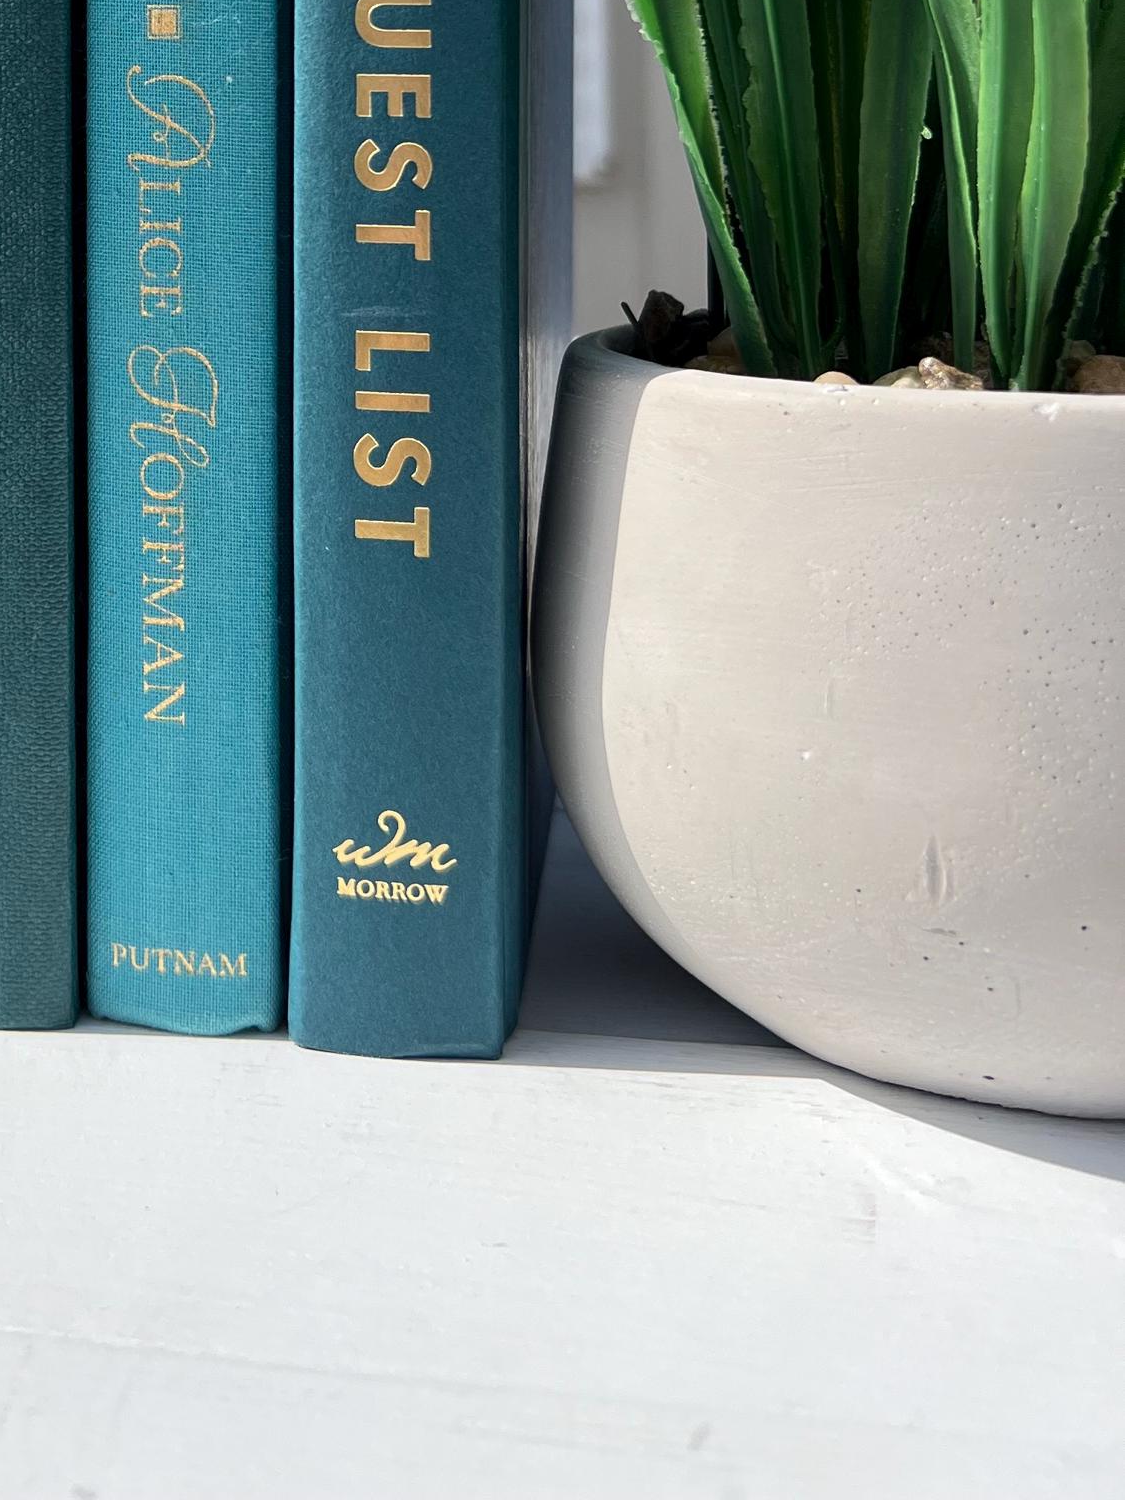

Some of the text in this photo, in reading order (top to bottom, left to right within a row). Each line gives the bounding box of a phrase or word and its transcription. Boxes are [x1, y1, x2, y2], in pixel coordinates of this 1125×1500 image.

[126, 66, 220, 726] ALICE HOFFMAN
[352, 330, 433, 560] LIST
[336, 876, 449, 904] MORROW
[111, 942, 249, 978] PUTNAM
